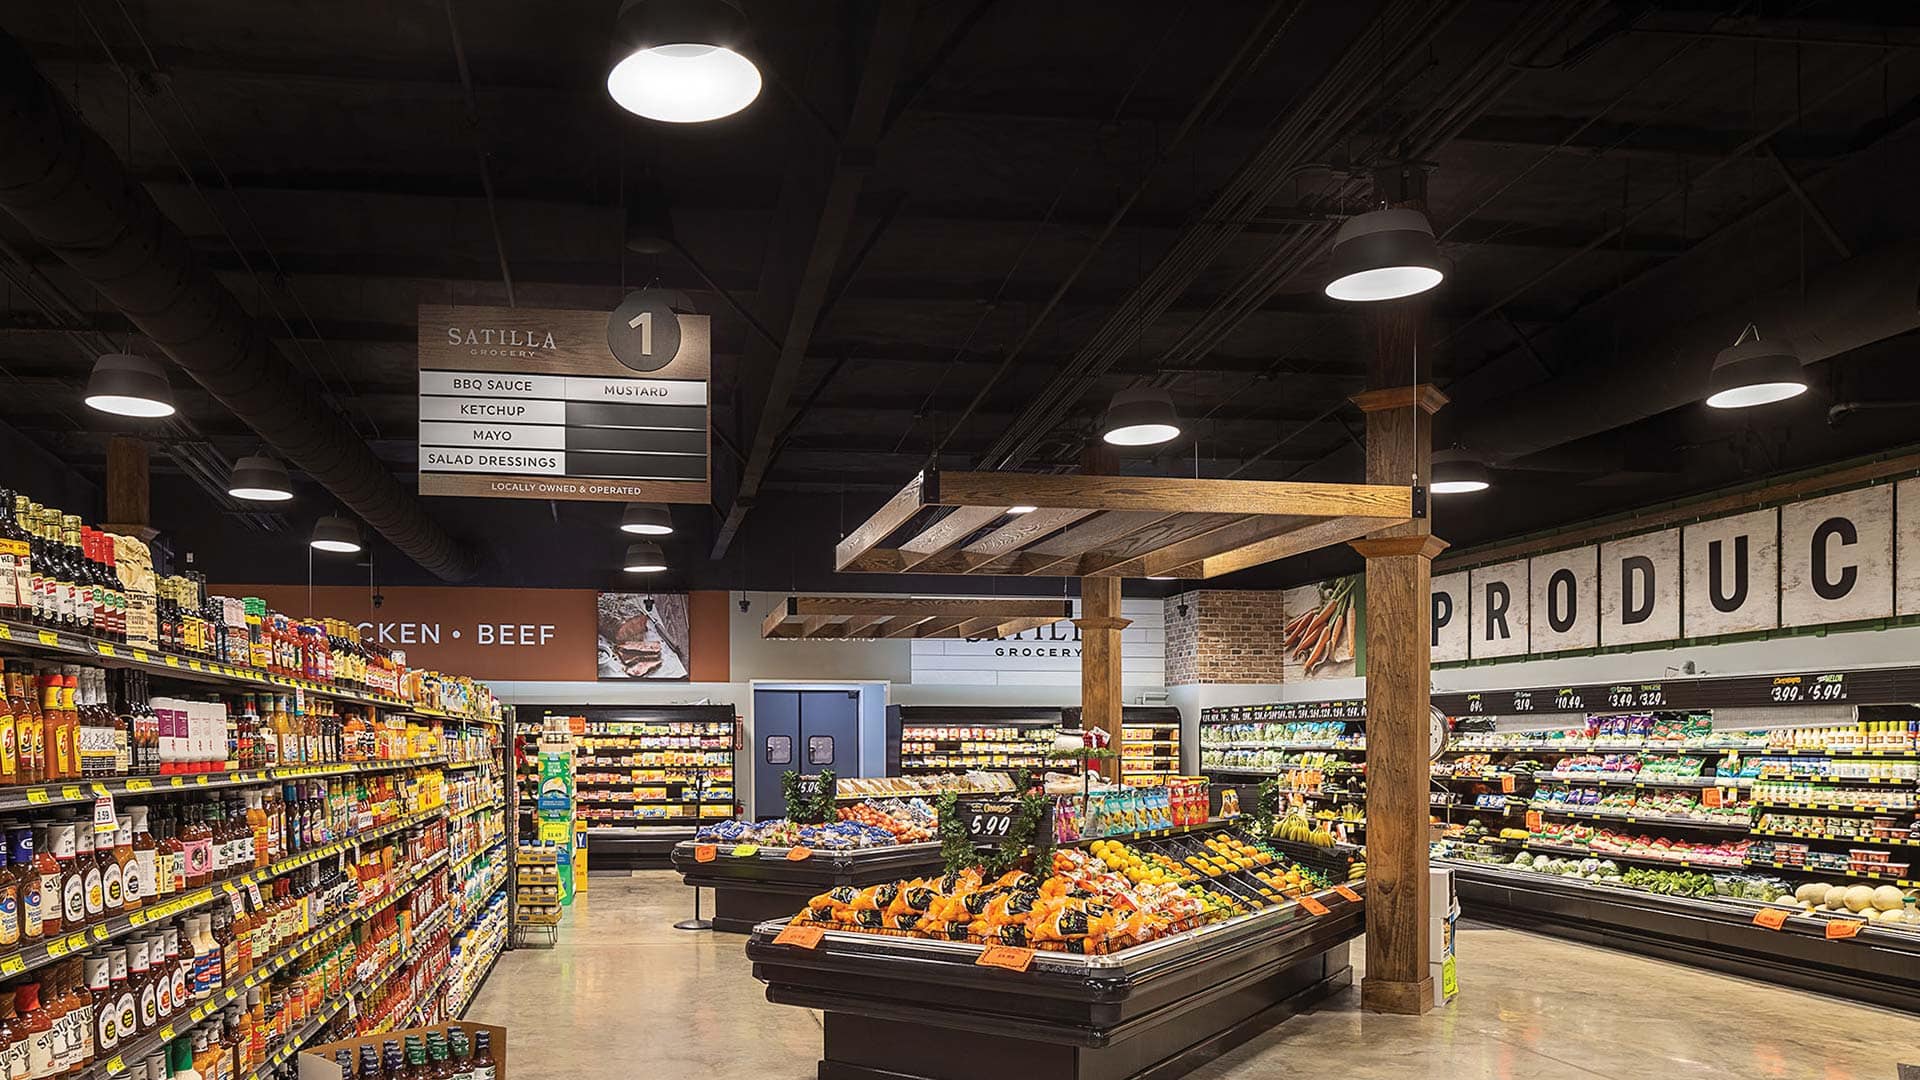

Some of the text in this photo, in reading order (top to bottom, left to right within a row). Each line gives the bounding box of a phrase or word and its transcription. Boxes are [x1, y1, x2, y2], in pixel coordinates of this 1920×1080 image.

[448, 327, 557, 350] SATILLA
[628, 311, 652, 355] 1
[470, 349, 536, 357] GROCERY
[453, 378, 532, 391] BBQ SAUCE
[604, 385, 668, 397] MUSTARD
[460, 404, 526, 417] KETCHUP
[473, 429, 512, 441] MAYO
[428, 453, 557, 468] SALAD DRESSINGS
[491, 483, 642, 496] LOCALLY OWNED & OPERATED
[356, 623, 555, 645] CKEN BEEF
[995, 647, 1081, 657] GROCERY
[971, 814, 1011, 836] 5.99
